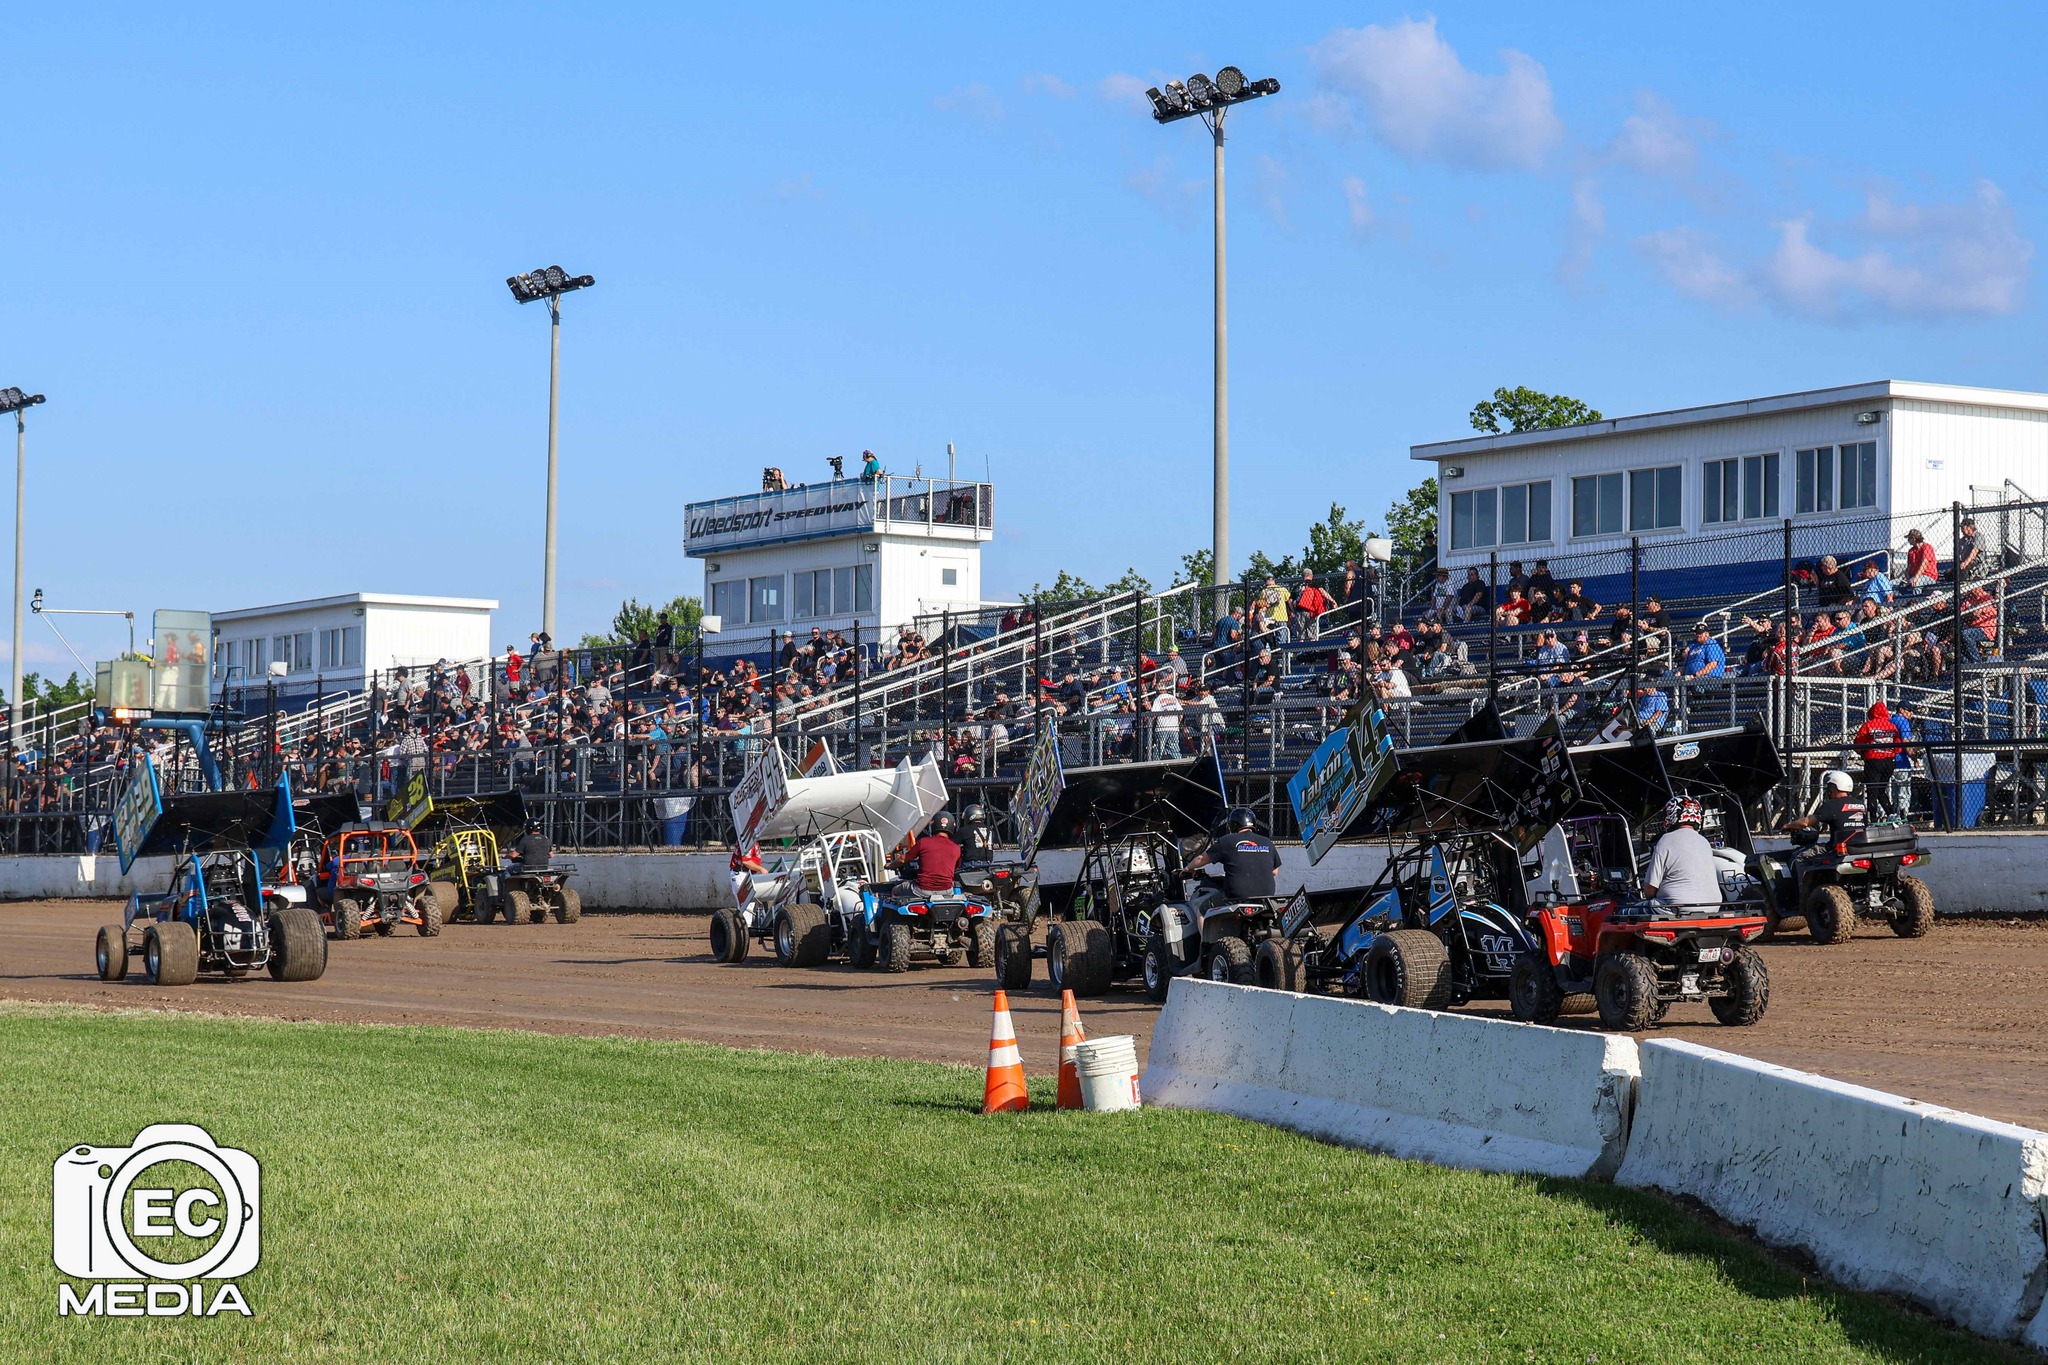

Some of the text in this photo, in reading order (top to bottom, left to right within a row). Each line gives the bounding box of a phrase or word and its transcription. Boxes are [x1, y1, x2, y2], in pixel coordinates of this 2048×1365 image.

[689, 501, 867, 539] Weedsport SPEEDWAY
[1346, 699, 1382, 790] 14
[407, 773, 424, 805] 28
[1301, 755, 1342, 810] Layton
[1389, 946, 1404, 989] Hoosier
[1480, 934, 1516, 972] 14
